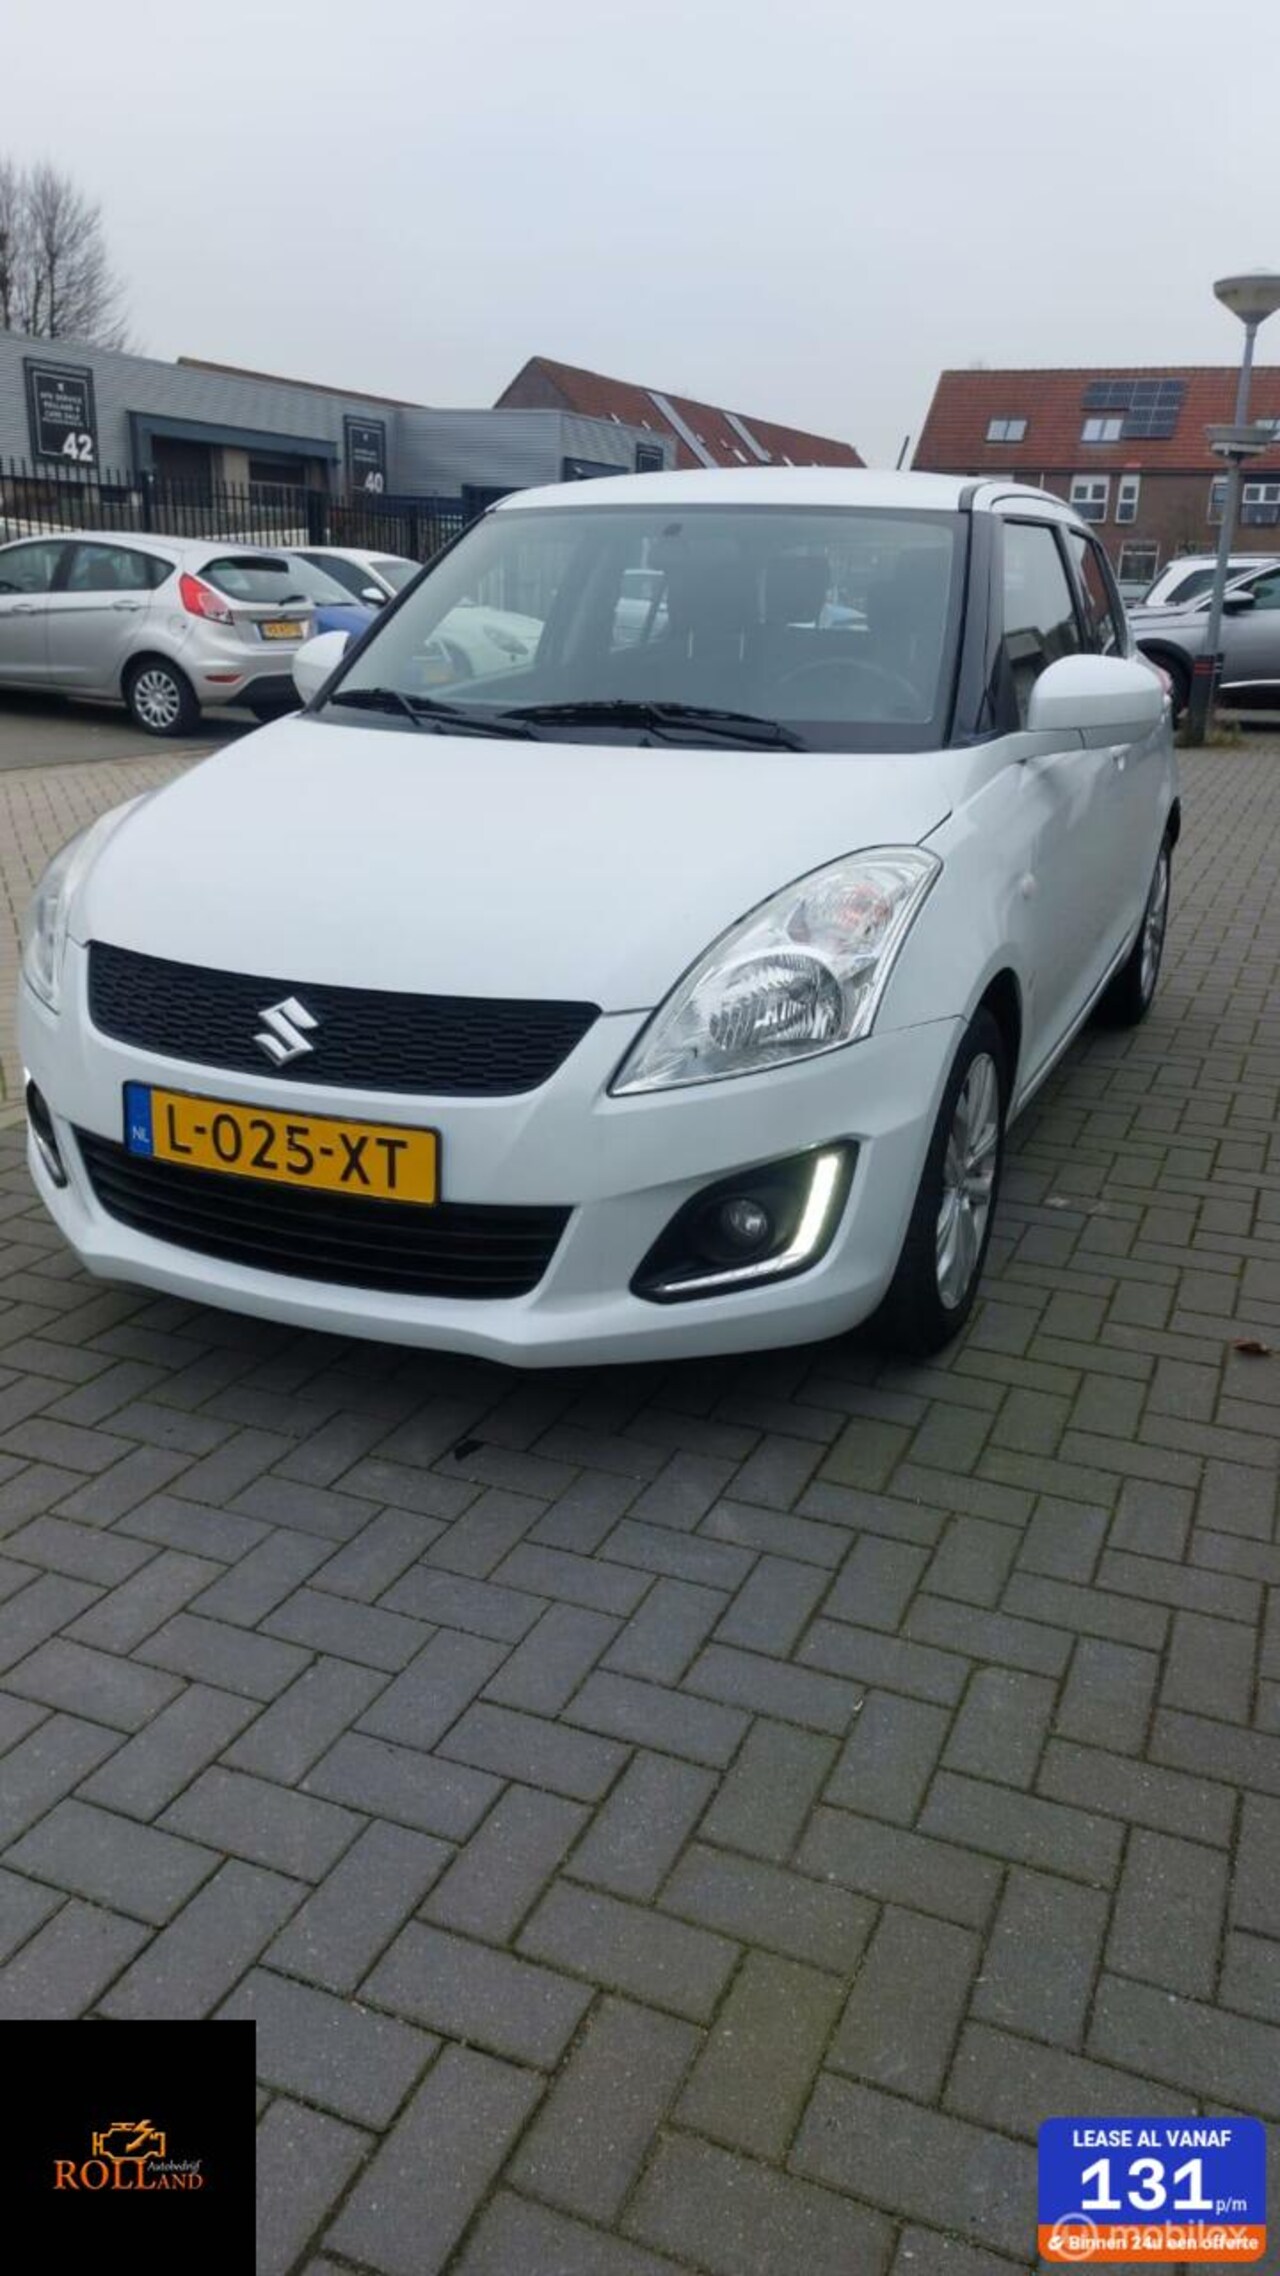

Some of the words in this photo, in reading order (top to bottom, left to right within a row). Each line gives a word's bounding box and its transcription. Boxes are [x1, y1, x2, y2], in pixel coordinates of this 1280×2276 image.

[63, 432, 93, 461] 42
[365, 471, 384, 494] 40
[132, 1125, 149, 1142] NL
[167, 1104, 408, 1188] L-025-XT
